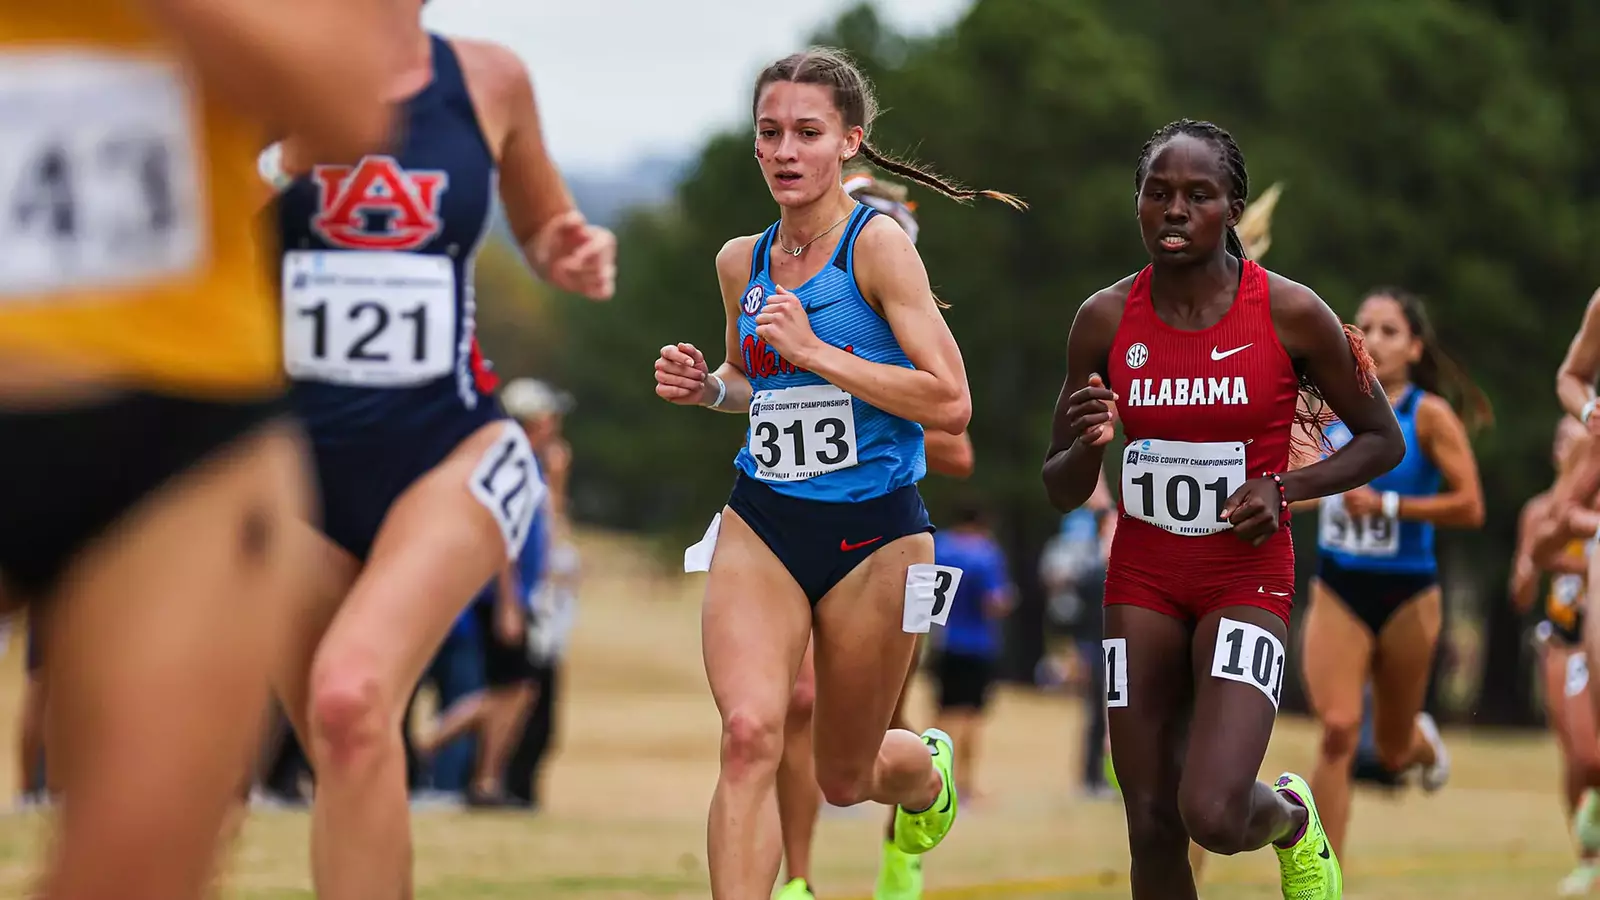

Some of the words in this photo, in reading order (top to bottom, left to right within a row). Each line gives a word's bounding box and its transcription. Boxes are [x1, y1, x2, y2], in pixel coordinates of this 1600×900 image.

[299, 300, 428, 362] 121
[1127, 344, 1147, 367] SEC
[760, 403, 775, 411] CROSS
[775, 402, 800, 411] COUNTRY
[800, 399, 849, 409] CHAMPIONSHIPS
[1128, 377, 1248, 406] ALABAMA
[755, 418, 850, 468] 313
[1139, 453, 1160, 463] CROSS
[1160, 456, 1190, 465] COUNTRY
[1190, 458, 1243, 467] CHAMPIONSHIPS
[1131, 472, 1229, 523] 101
[1221, 628, 1284, 704] 101
